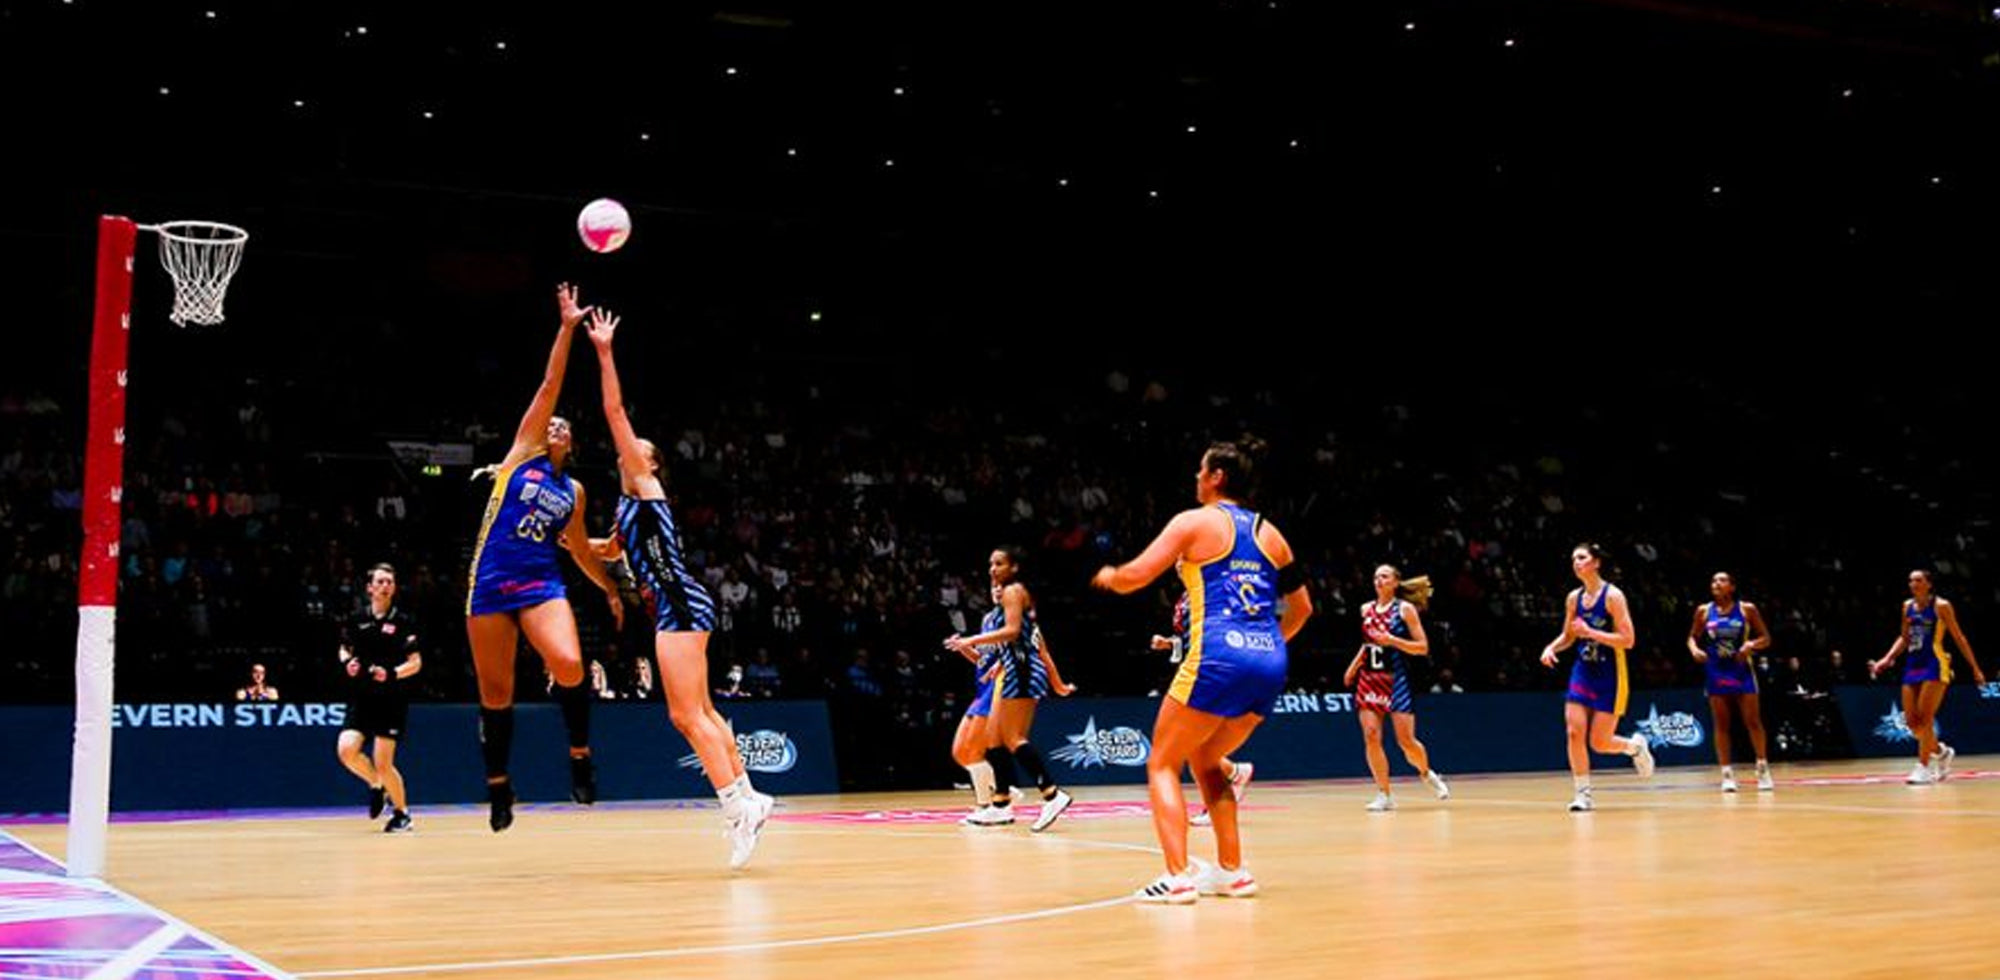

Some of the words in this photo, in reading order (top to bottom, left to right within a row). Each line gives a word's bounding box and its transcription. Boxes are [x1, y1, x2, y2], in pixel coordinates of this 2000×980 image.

[1370, 645, 1384, 669] C
[1273, 693, 1320, 712] ERN
[112, 703, 224, 727] EVERN
[234, 703, 347, 726] STARS
[736, 733, 786, 751] SEVERN
